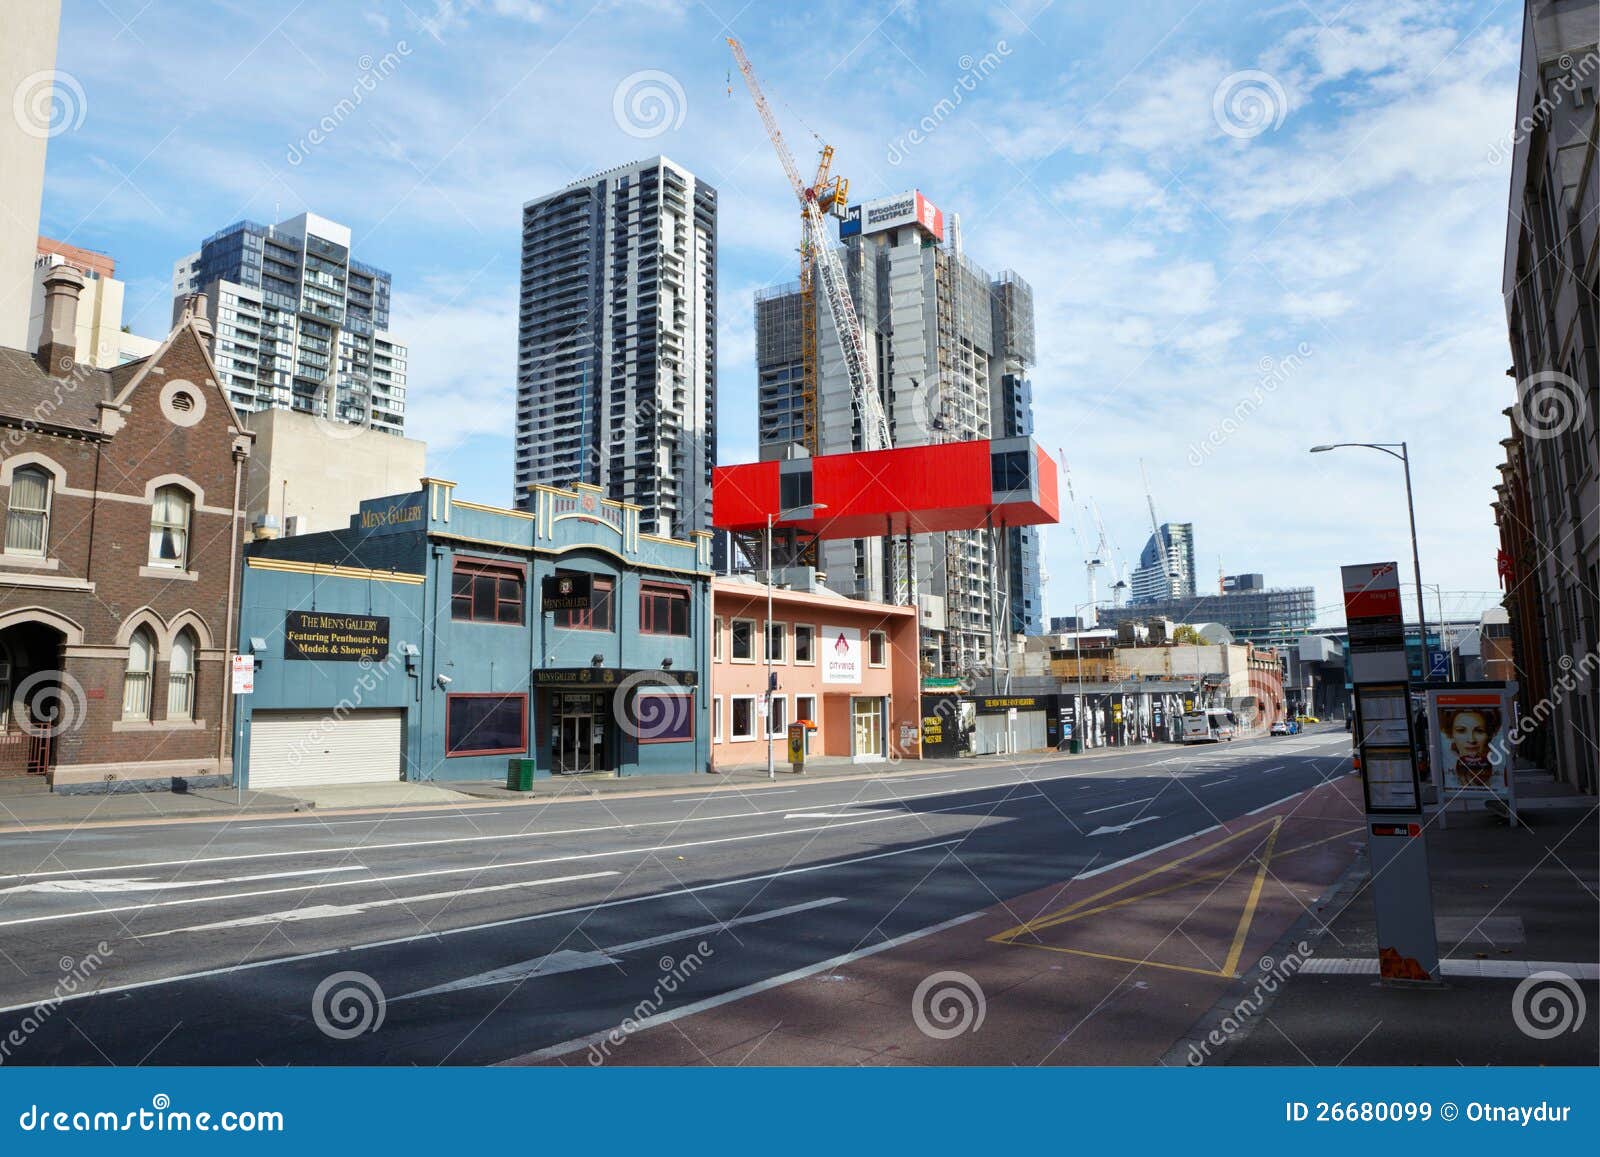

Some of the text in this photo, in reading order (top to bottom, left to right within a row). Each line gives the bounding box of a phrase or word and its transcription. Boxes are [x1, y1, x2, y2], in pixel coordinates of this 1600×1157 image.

[388, 505, 422, 525] GALLERY
[301, 615, 378, 631] THE MEN'S GALLERY
[288, 631, 388, 645] Featuring Penthouse Pets
[299, 643, 378, 657] Models & Showgirls
[1434, 653, 1443, 664] P
